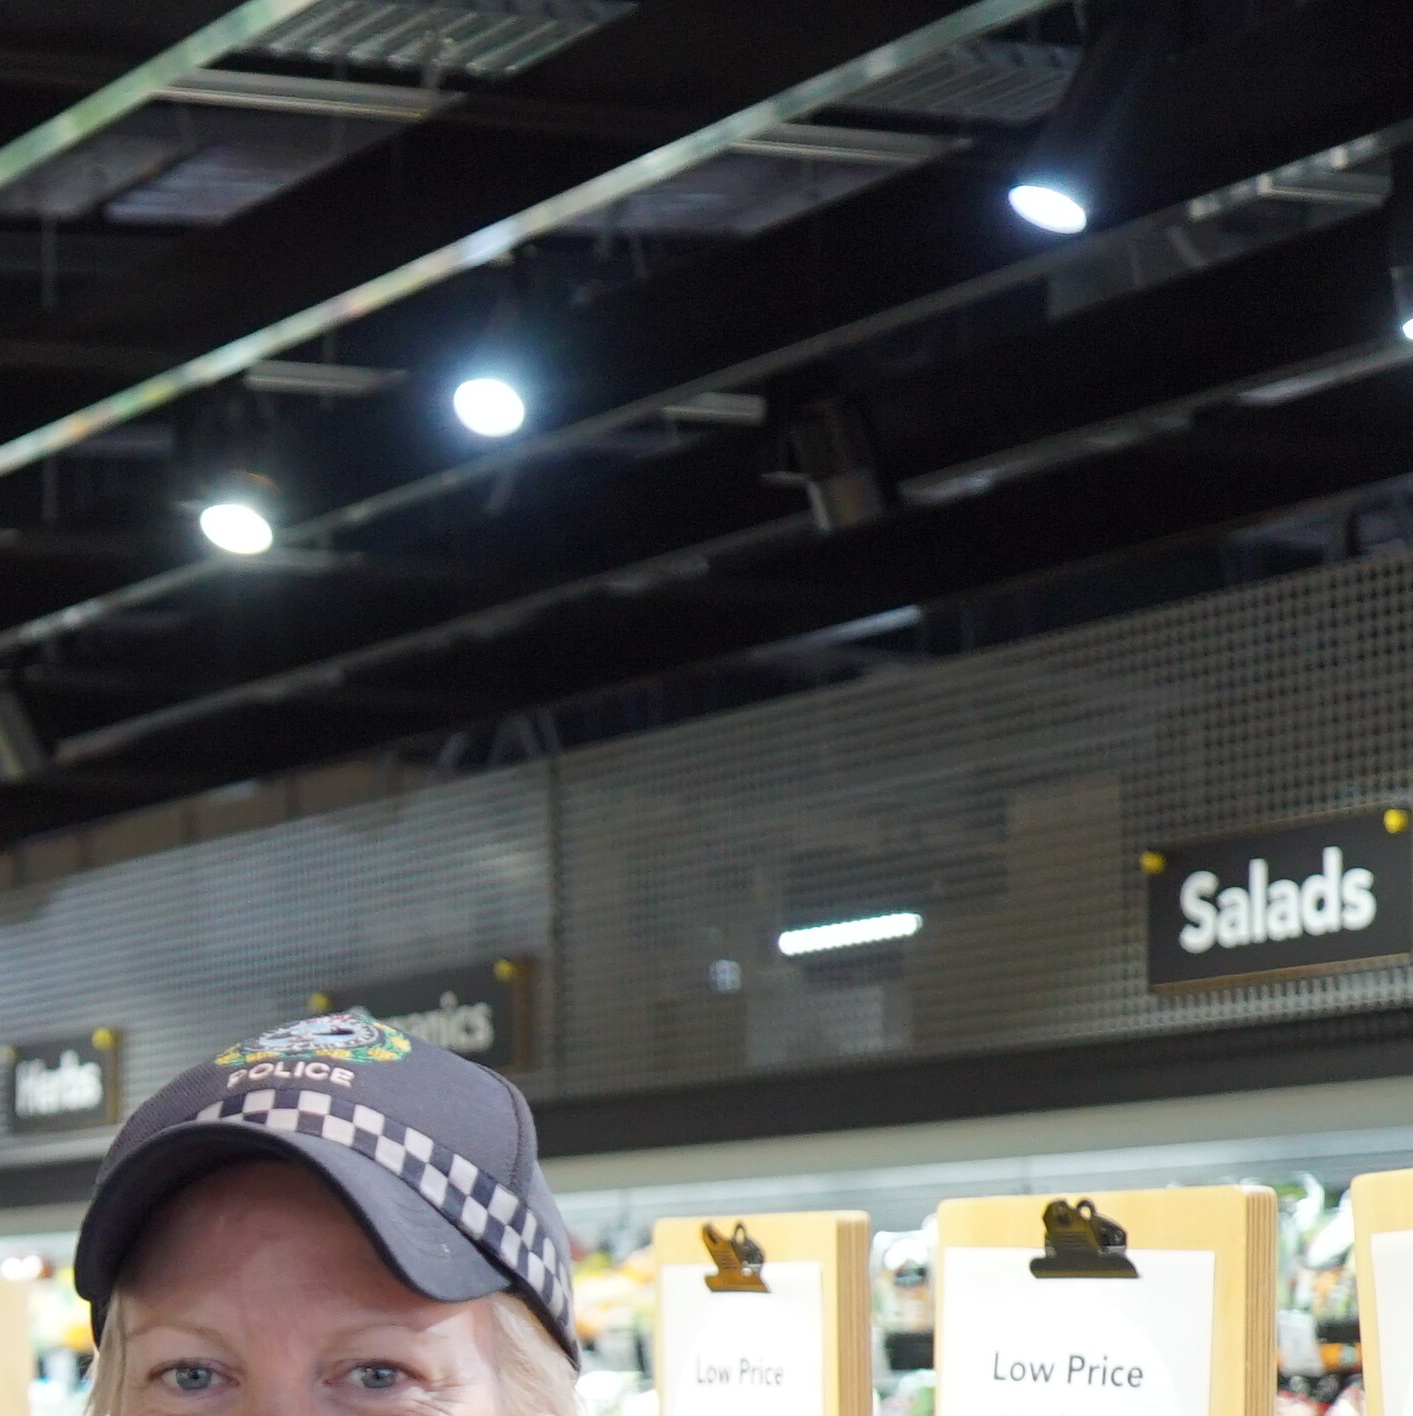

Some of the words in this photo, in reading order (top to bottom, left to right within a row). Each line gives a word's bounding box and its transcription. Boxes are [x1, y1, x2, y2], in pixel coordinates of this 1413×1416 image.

[1177, 844, 1377, 955] Salads
[227, 1061, 355, 1089] POLICE
[695, 1357, 730, 1384] Low
[739, 1357, 784, 1386] Price
[992, 1351, 1055, 1384] Low
[1066, 1354, 1144, 1389] Price
